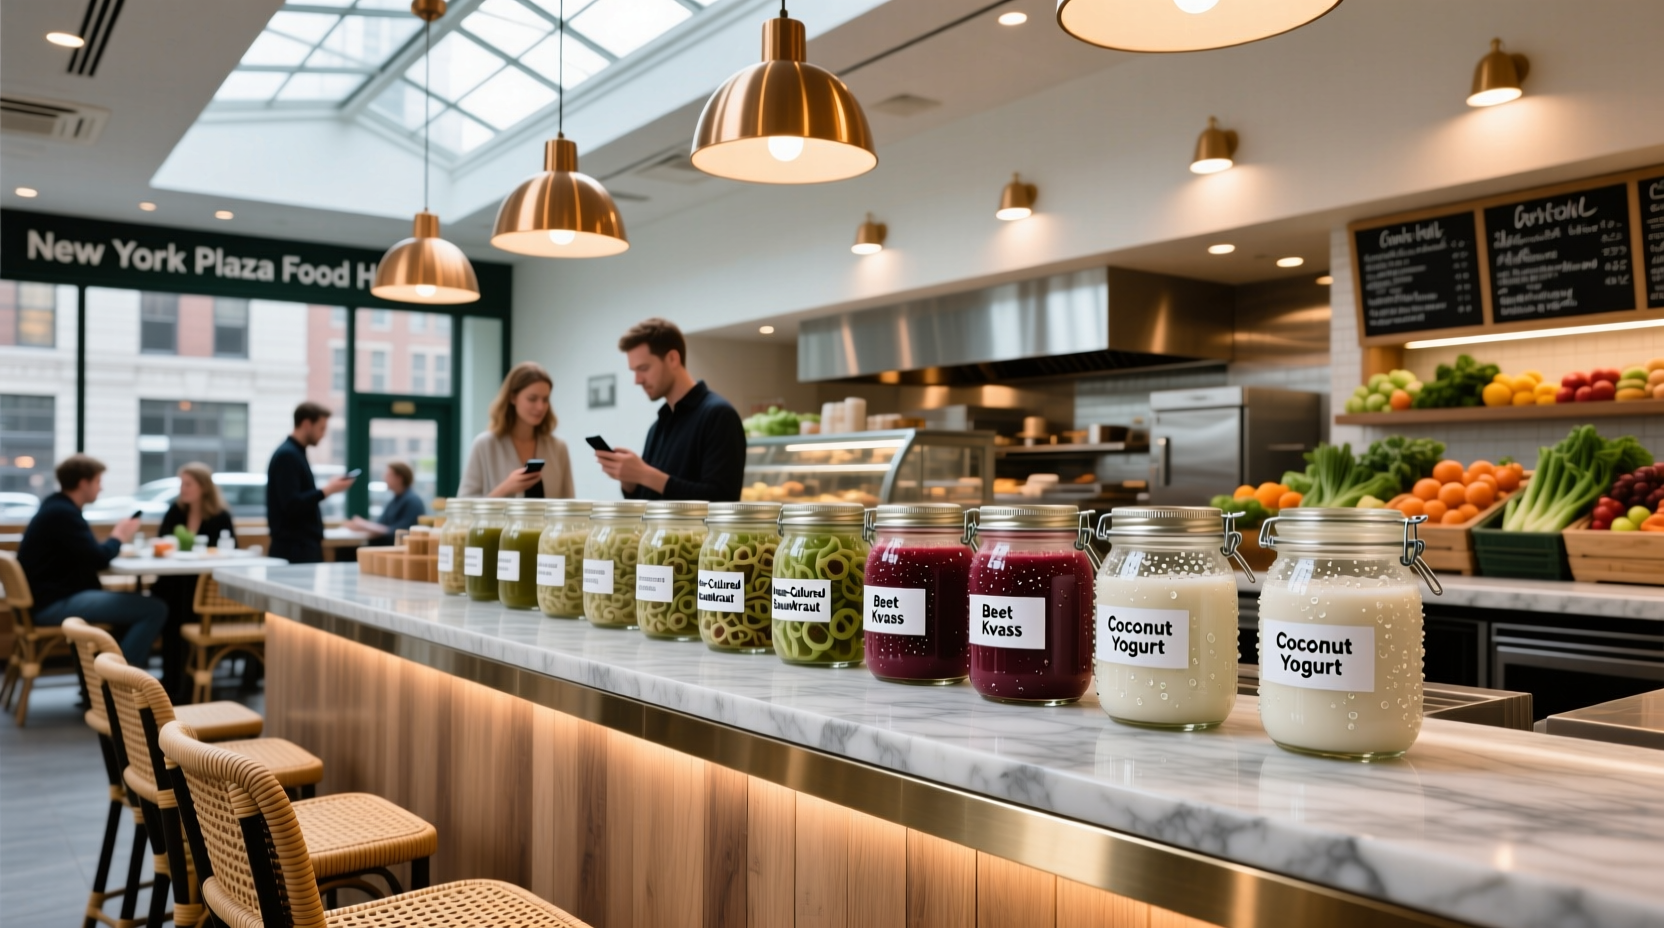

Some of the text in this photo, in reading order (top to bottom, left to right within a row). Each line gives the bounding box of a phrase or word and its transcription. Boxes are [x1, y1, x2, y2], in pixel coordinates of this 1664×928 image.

[27, 230, 105, 266] New
[112, 238, 186, 274] York
[194, 246, 274, 282] Plaza
[282, 256, 350, 288] Food
[873, 595, 899, 609] Beet
[982, 604, 1013, 620] Beet
[872, 609, 905, 625] Kvass
[1108, 615, 1173, 636] Coconut
[982, 620, 1023, 637] Kvass
[1112, 635, 1165, 657] Yogurt
[1276, 632, 1353, 655] Coconut
[1281, 654, 1343, 678] Yogurt
